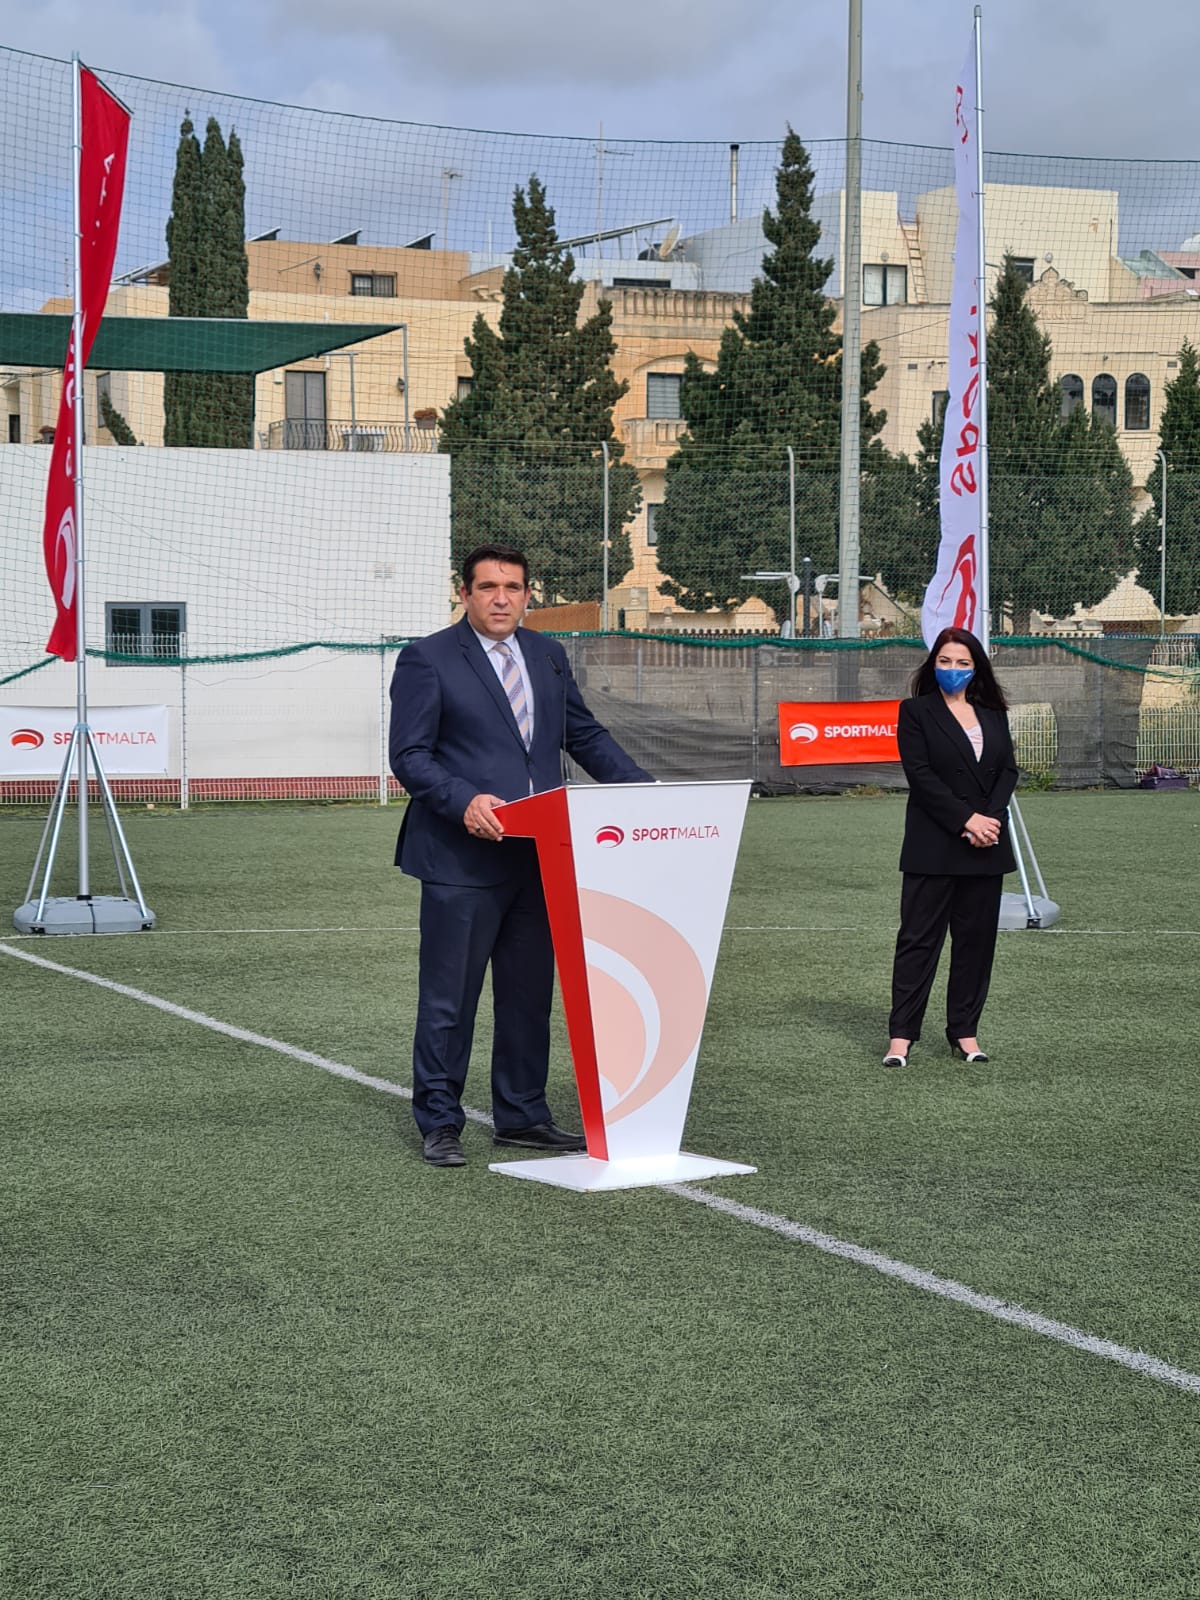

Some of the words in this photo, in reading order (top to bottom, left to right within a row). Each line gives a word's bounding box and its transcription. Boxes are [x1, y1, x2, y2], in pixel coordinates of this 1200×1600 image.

[823, 724, 898, 738] SPORTMAL
[53, 732, 157, 745] SPTMALTA
[632, 825, 720, 841] SPORTMALTA
